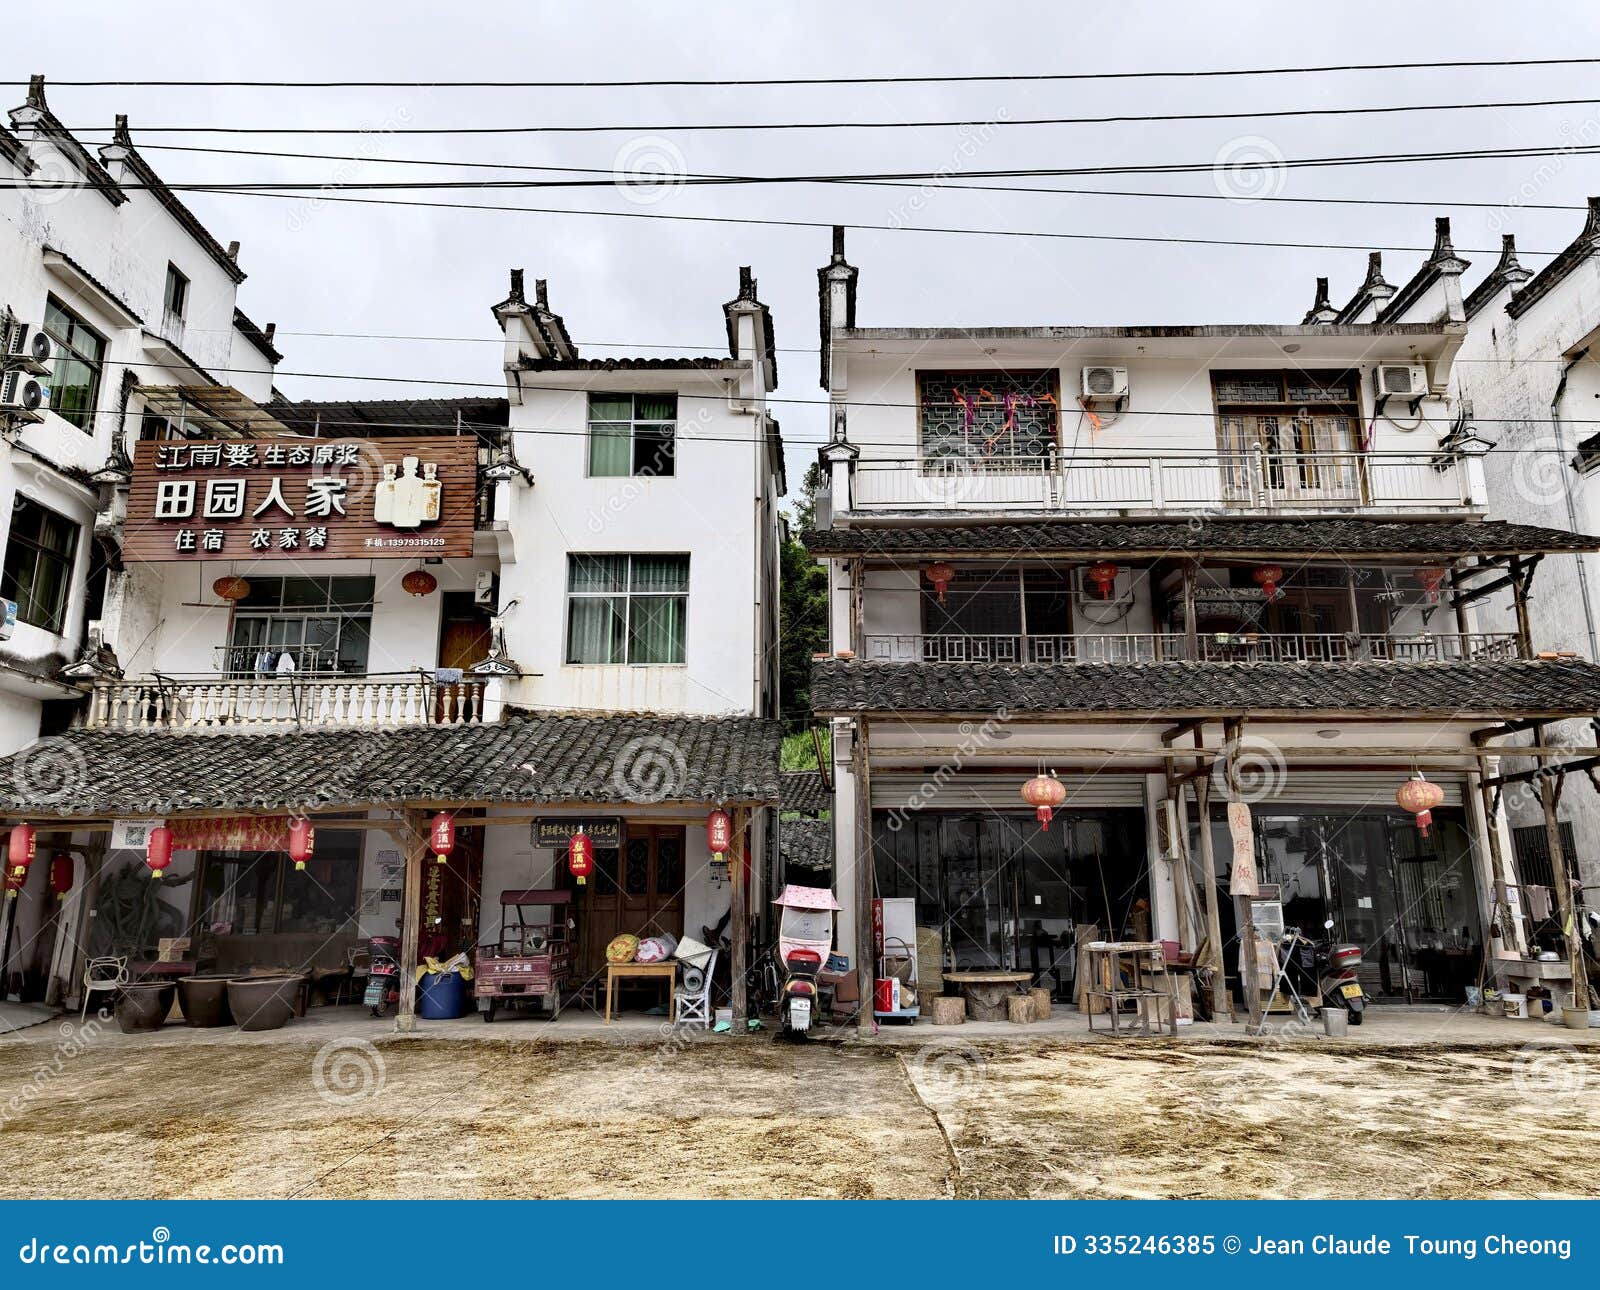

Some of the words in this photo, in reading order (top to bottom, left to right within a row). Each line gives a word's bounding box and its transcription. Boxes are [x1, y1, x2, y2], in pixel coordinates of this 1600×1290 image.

[264, 444, 359, 465] 生态原浆
[154, 476, 349, 519] 田园人家
[174, 529, 224, 551] 住宿
[250, 527, 328, 549] 农家餐
